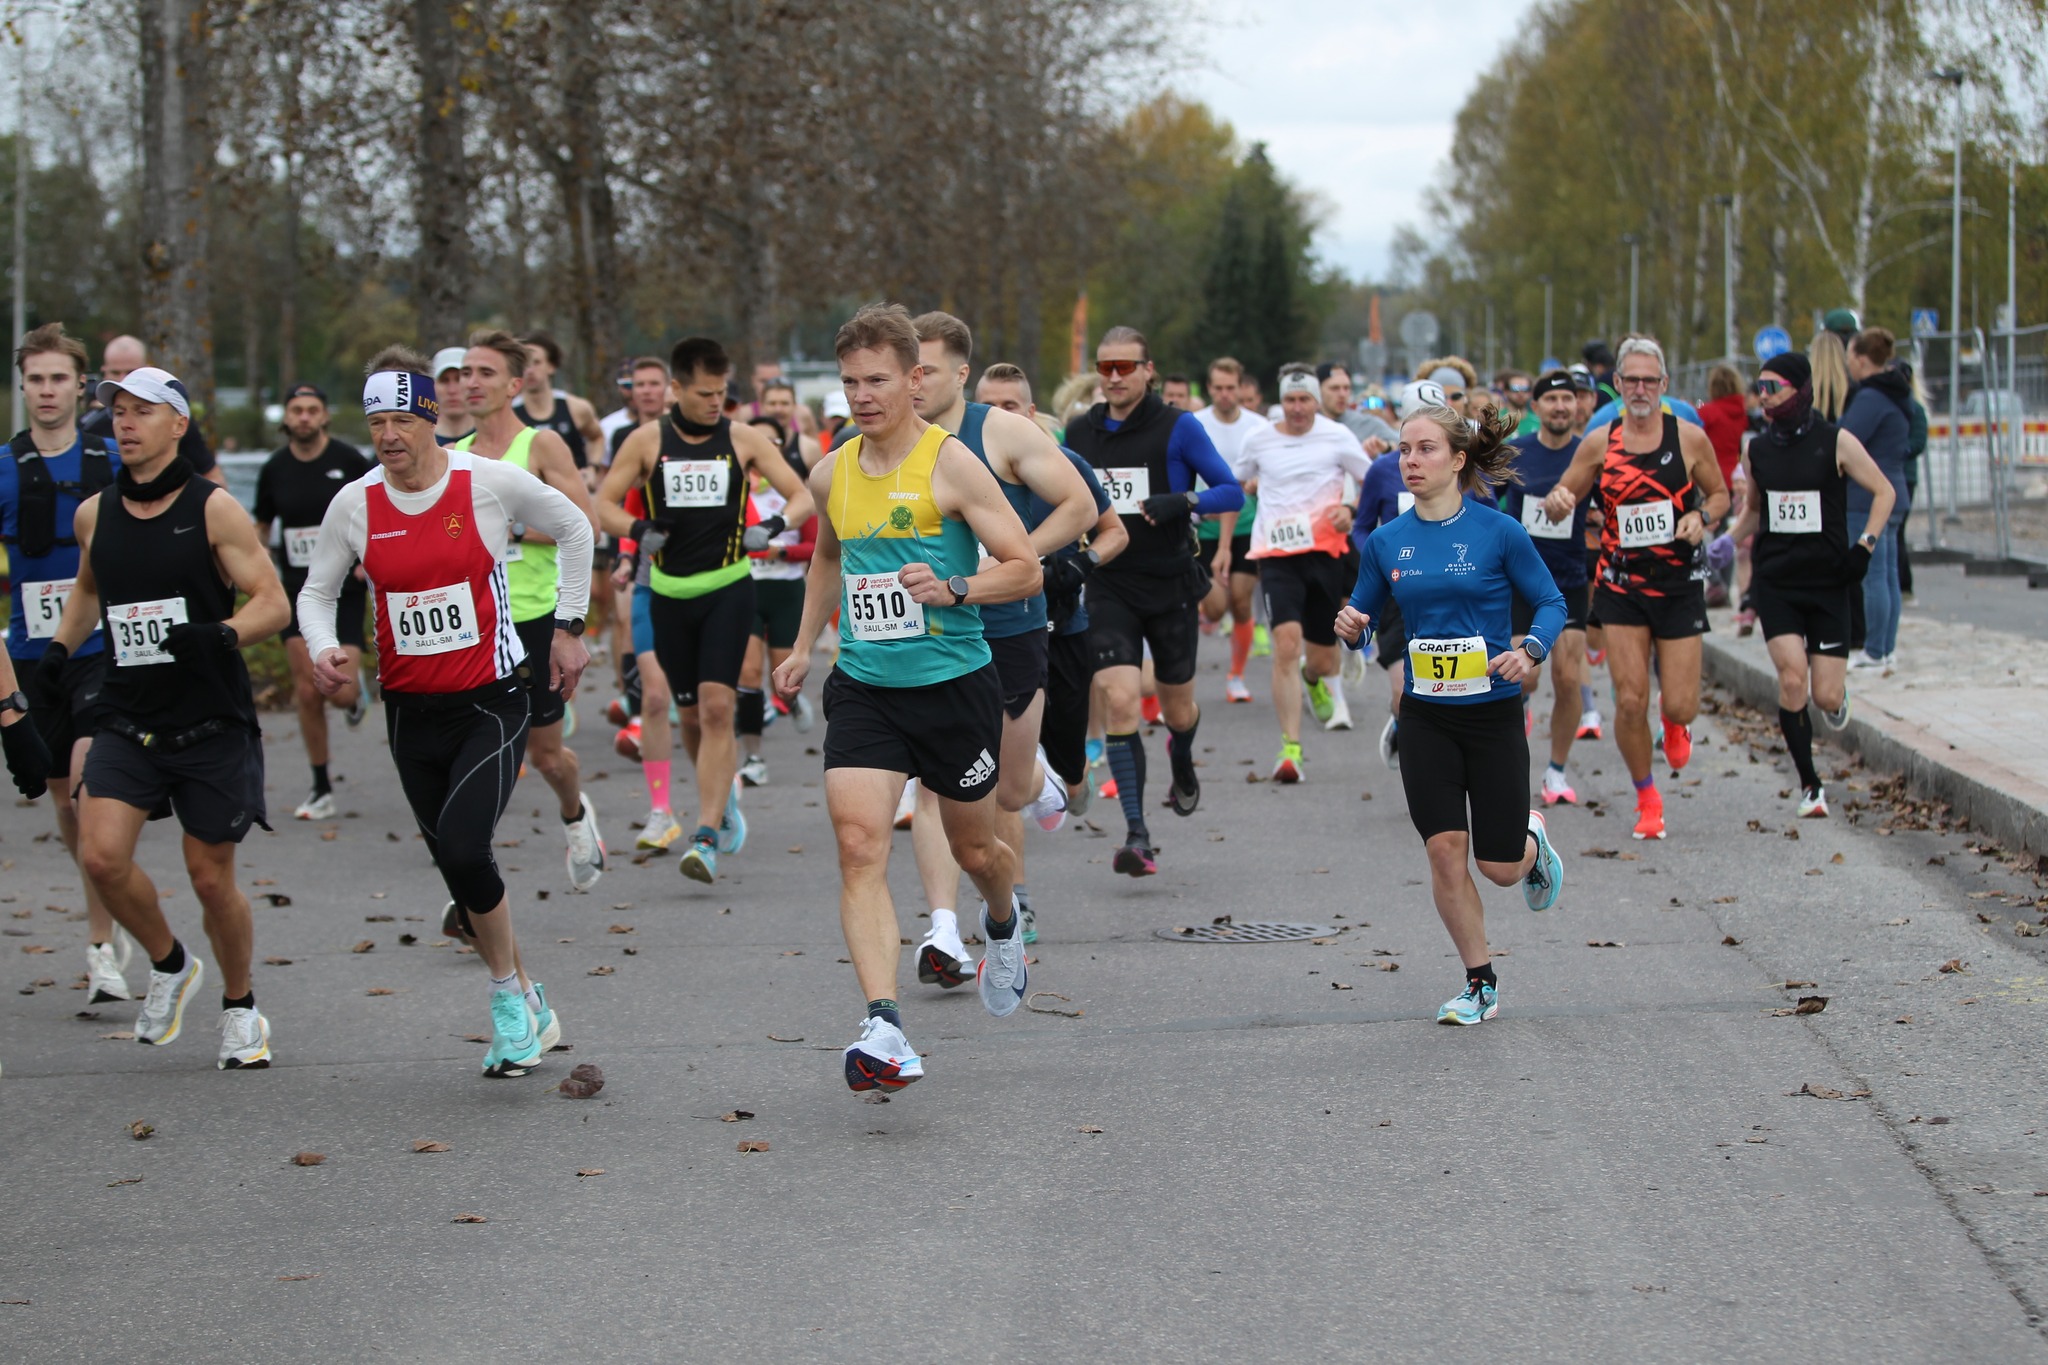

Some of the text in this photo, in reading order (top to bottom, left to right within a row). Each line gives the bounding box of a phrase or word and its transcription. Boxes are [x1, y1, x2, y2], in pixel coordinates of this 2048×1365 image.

[397, 373, 409, 408] VAM
[672, 474, 718, 493] 3506
[1102, 481, 1133, 500] 559
[888, 492, 920, 501] TRIMTEX
[1441, 506, 1467, 527] noname
[1778, 504, 1807, 521] 523
[1625, 513, 1667, 535] 6005
[371, 529, 407, 540] noname
[1270, 524, 1305, 545] 6004
[421, 591, 448, 600] vantaan
[422, 597, 448, 606] energia
[852, 591, 906, 620] 5510
[399, 604, 462, 637] 6008
[863, 623, 898, 633] SAUL-SM
[415, 635, 453, 648] SAUL-SM
[1418, 642, 1461, 653] CRAFT
[1431, 655, 1459, 679] 57
